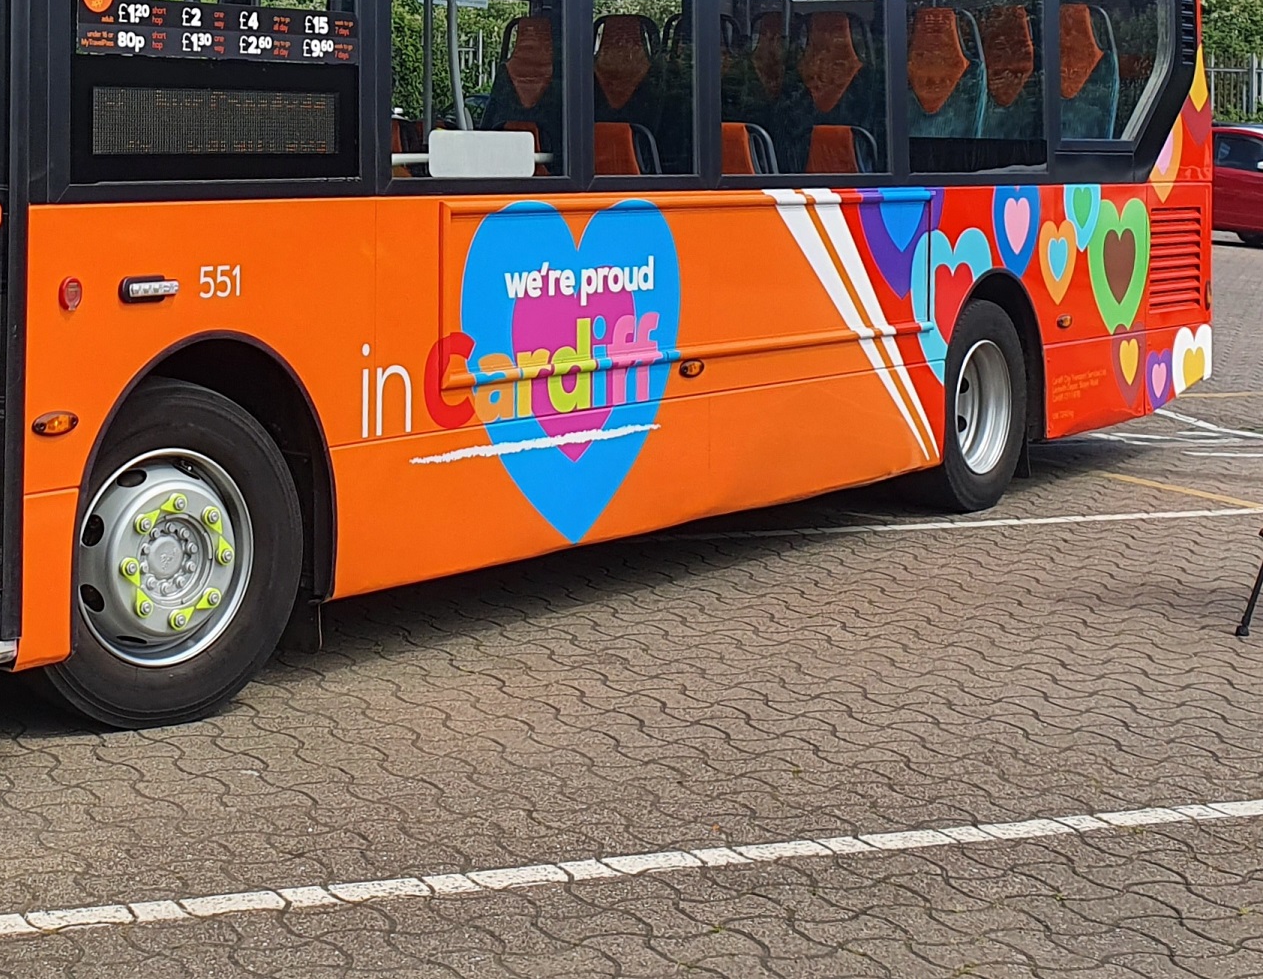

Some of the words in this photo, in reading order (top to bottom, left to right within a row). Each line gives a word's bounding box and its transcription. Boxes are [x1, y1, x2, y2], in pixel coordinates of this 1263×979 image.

[118, 3, 150, 24] £1.20
[152, 7, 167, 15] short
[152, 16, 163, 26] hop
[182, 7, 202, 27] £2
[239, 11, 259, 30] £4
[304, 15, 329, 35] £15
[117, 31, 145, 52] 80p
[152, 32, 167, 40] short
[152, 41, 163, 51] hop
[182, 32, 212, 52] £1.30
[239, 35, 273, 55] £2.60
[303, 39, 334, 57] £9.60
[199, 264, 241, 299] 551
[504, 261, 576, 299] we're
[580, 255, 655, 307] proud
[361, 343, 412, 438] in
[423, 311, 660, 430] Cardiff
